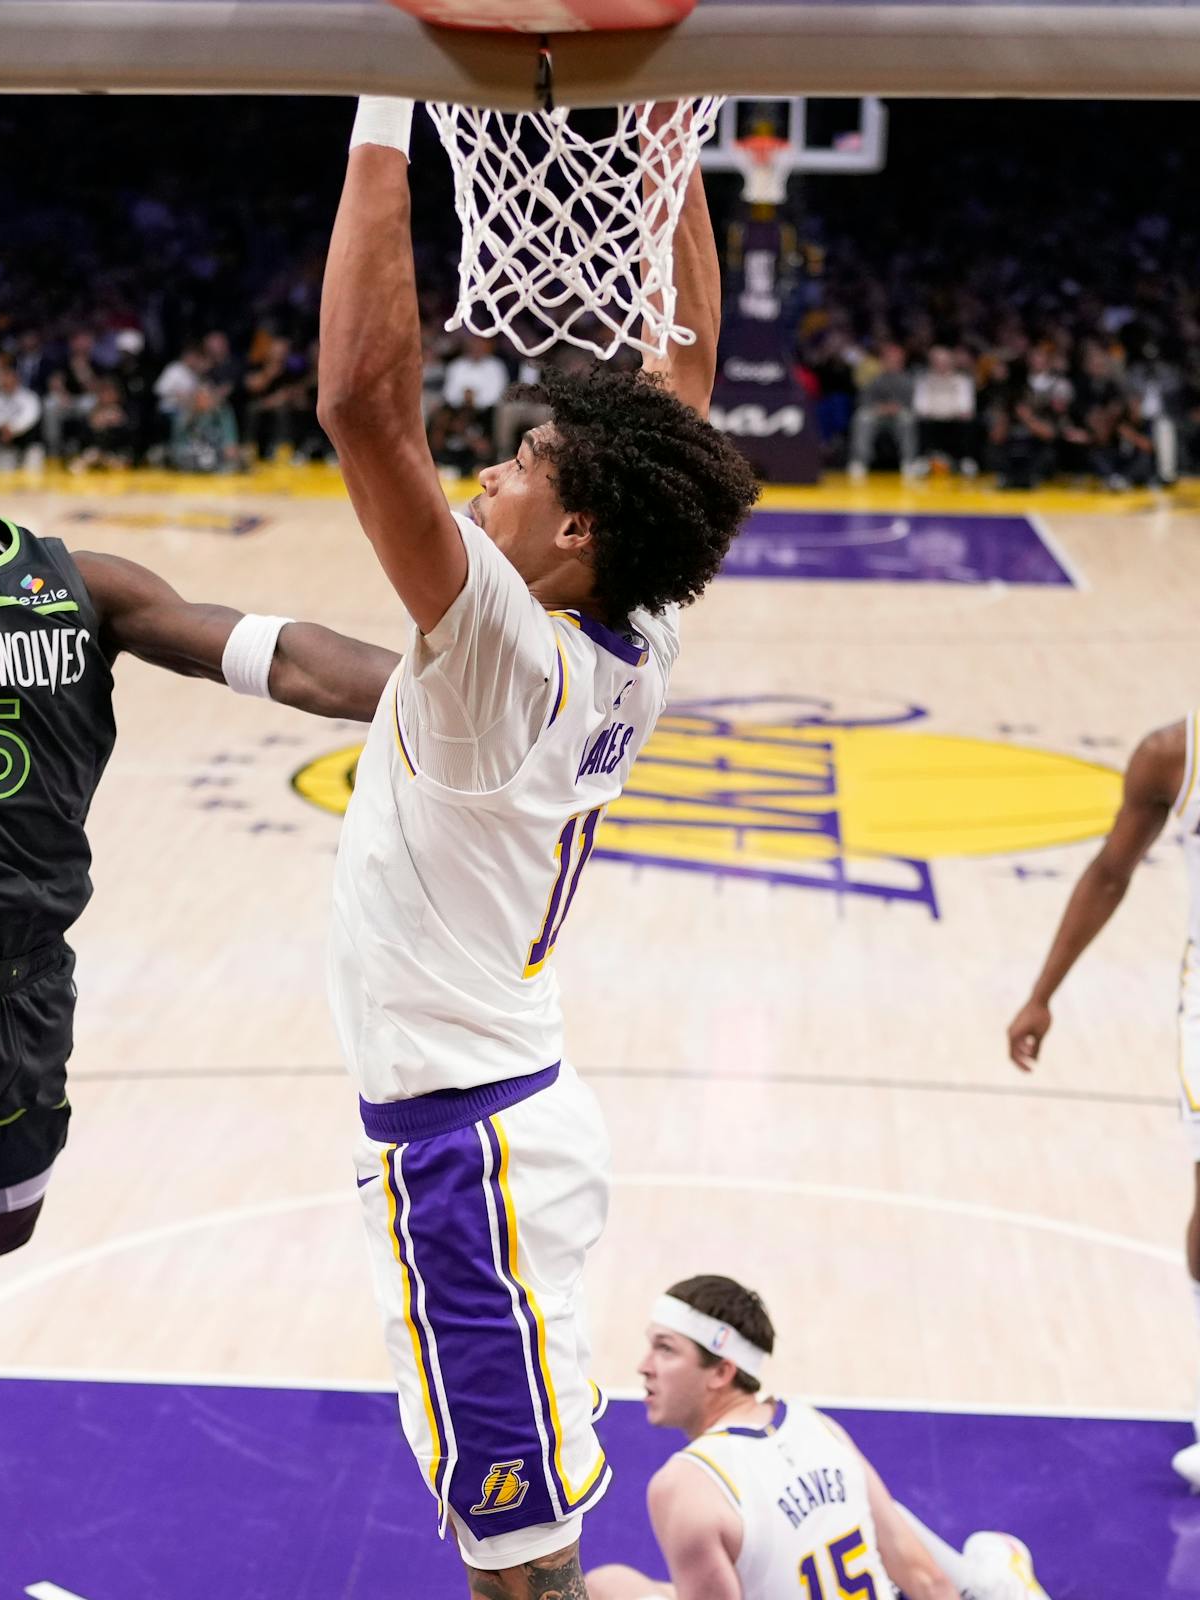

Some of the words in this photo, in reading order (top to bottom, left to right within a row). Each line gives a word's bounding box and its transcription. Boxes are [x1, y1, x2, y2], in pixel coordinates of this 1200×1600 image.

[522, 803, 604, 979] 11
[778, 1469, 846, 1528] REAVES
[799, 1524, 878, 1600] 15
